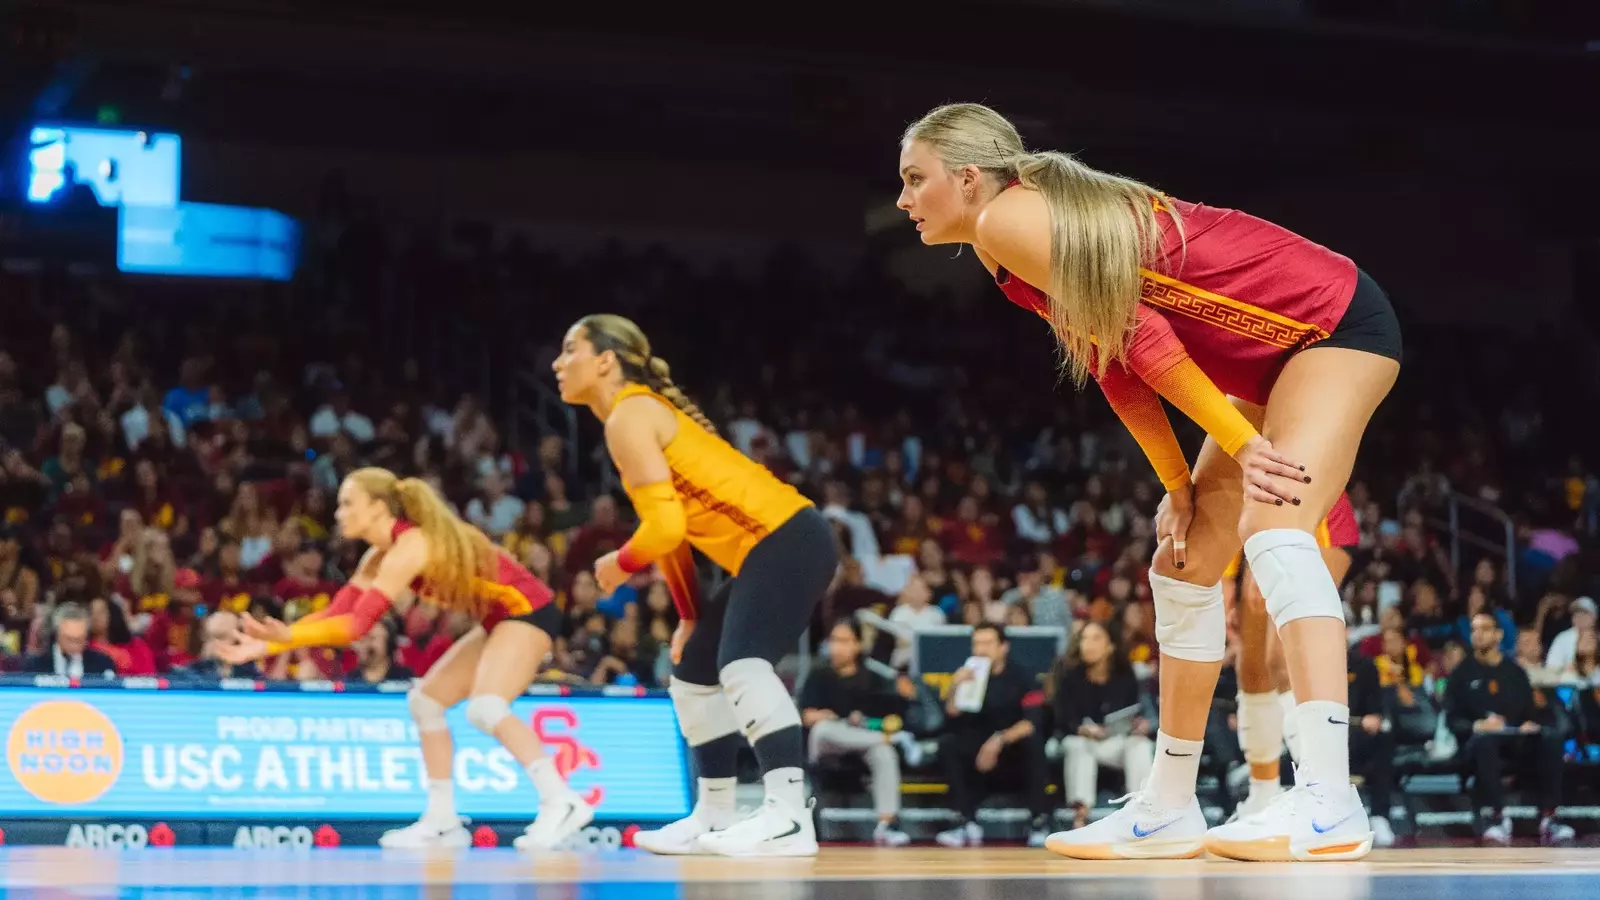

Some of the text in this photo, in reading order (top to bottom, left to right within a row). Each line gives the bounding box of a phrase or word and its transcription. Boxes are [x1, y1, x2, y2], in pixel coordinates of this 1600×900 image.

[26, 729, 105, 750] HIGH
[217, 716, 298, 741] PROUD
[301, 717, 405, 742] PARTNER
[19, 753, 112, 774] NOON
[142, 744, 518, 792] USC ATHLETCS
[65, 823, 148, 849] ARCO
[233, 825, 313, 850] ARCO
